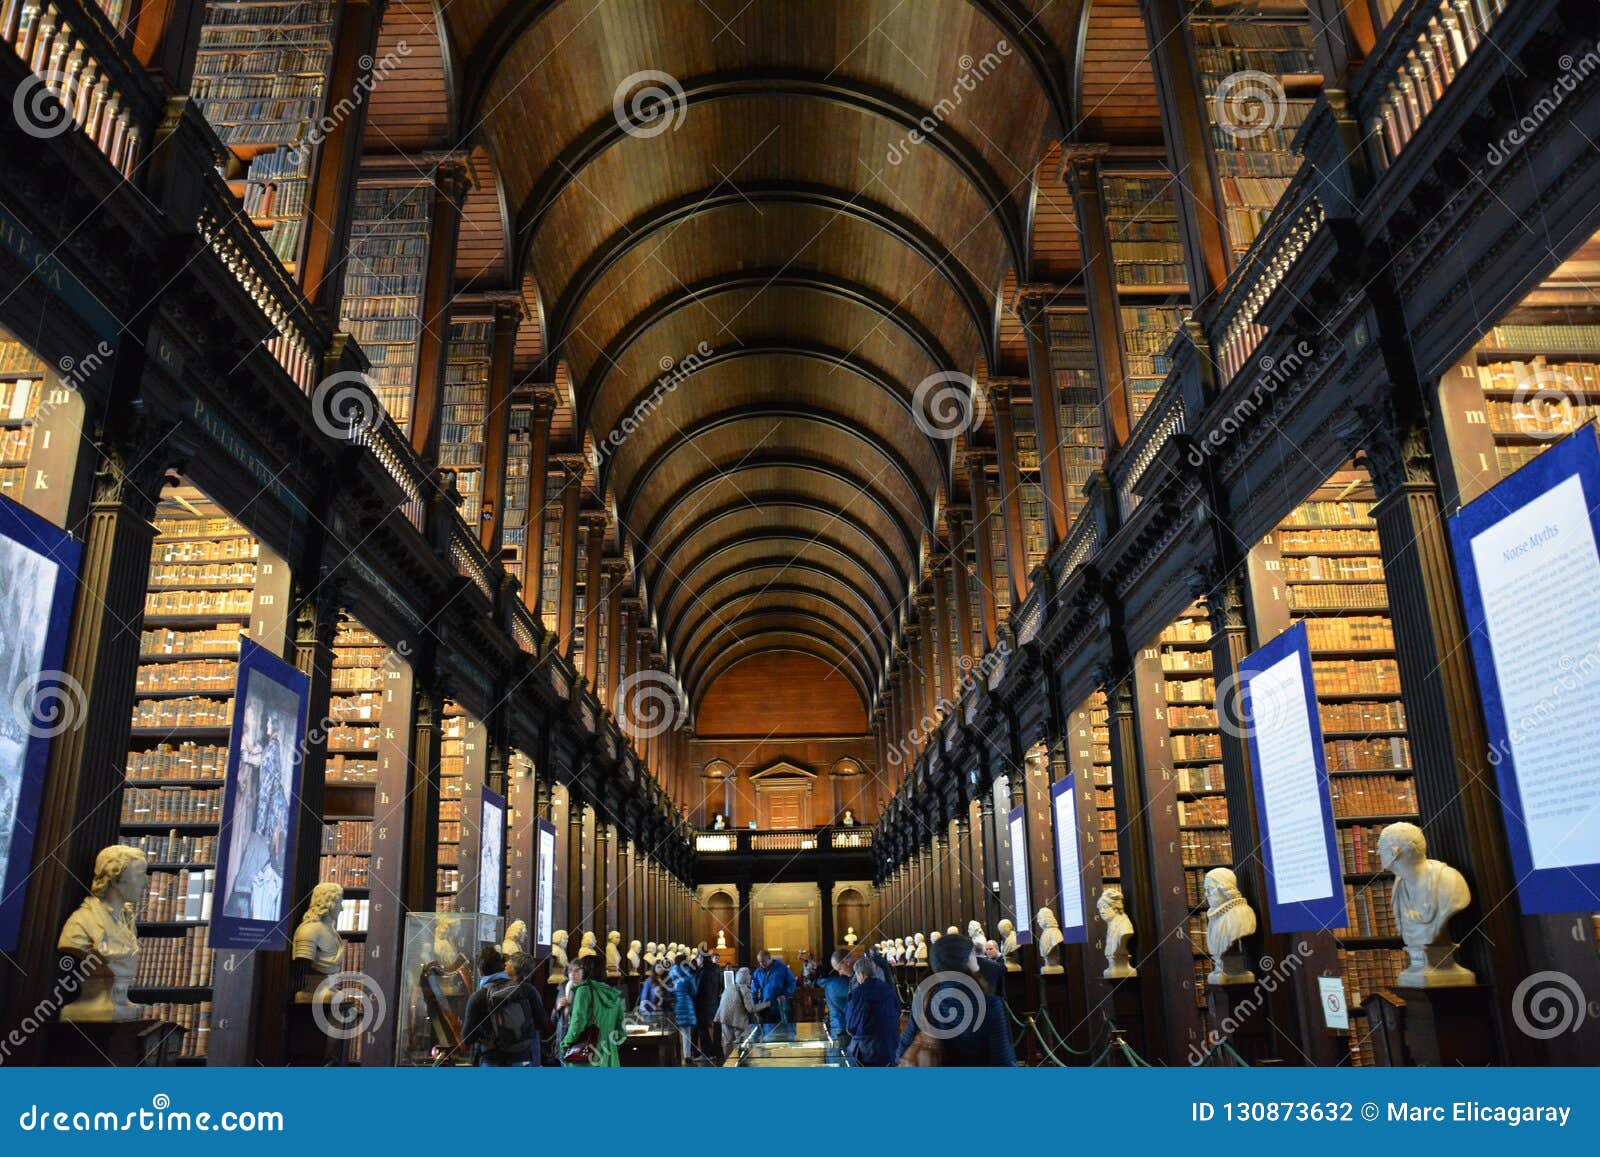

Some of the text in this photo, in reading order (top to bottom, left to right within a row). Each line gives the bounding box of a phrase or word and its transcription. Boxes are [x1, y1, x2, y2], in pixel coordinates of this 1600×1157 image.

[1460, 365, 1475, 378] n
[1464, 410, 1487, 424] m
[1478, 452, 1489, 471] l
[34, 470, 49, 490] k
[1263, 535, 1274, 544] n
[1502, 524, 1560, 563] Norse Myths
[262, 564, 273, 575] n
[1265, 560, 1280, 571] m
[259, 594, 274, 605] m
[1144, 649, 1158, 659] m
[388, 671, 401, 679] m
[1155, 707, 1164, 720] k
[386, 727, 395, 739] k
[465, 782, 472, 791] k
[380, 792, 389, 804] h
[1572, 918, 1585, 941] d
[371, 945, 380, 958] d
[223, 953, 236, 972] d
